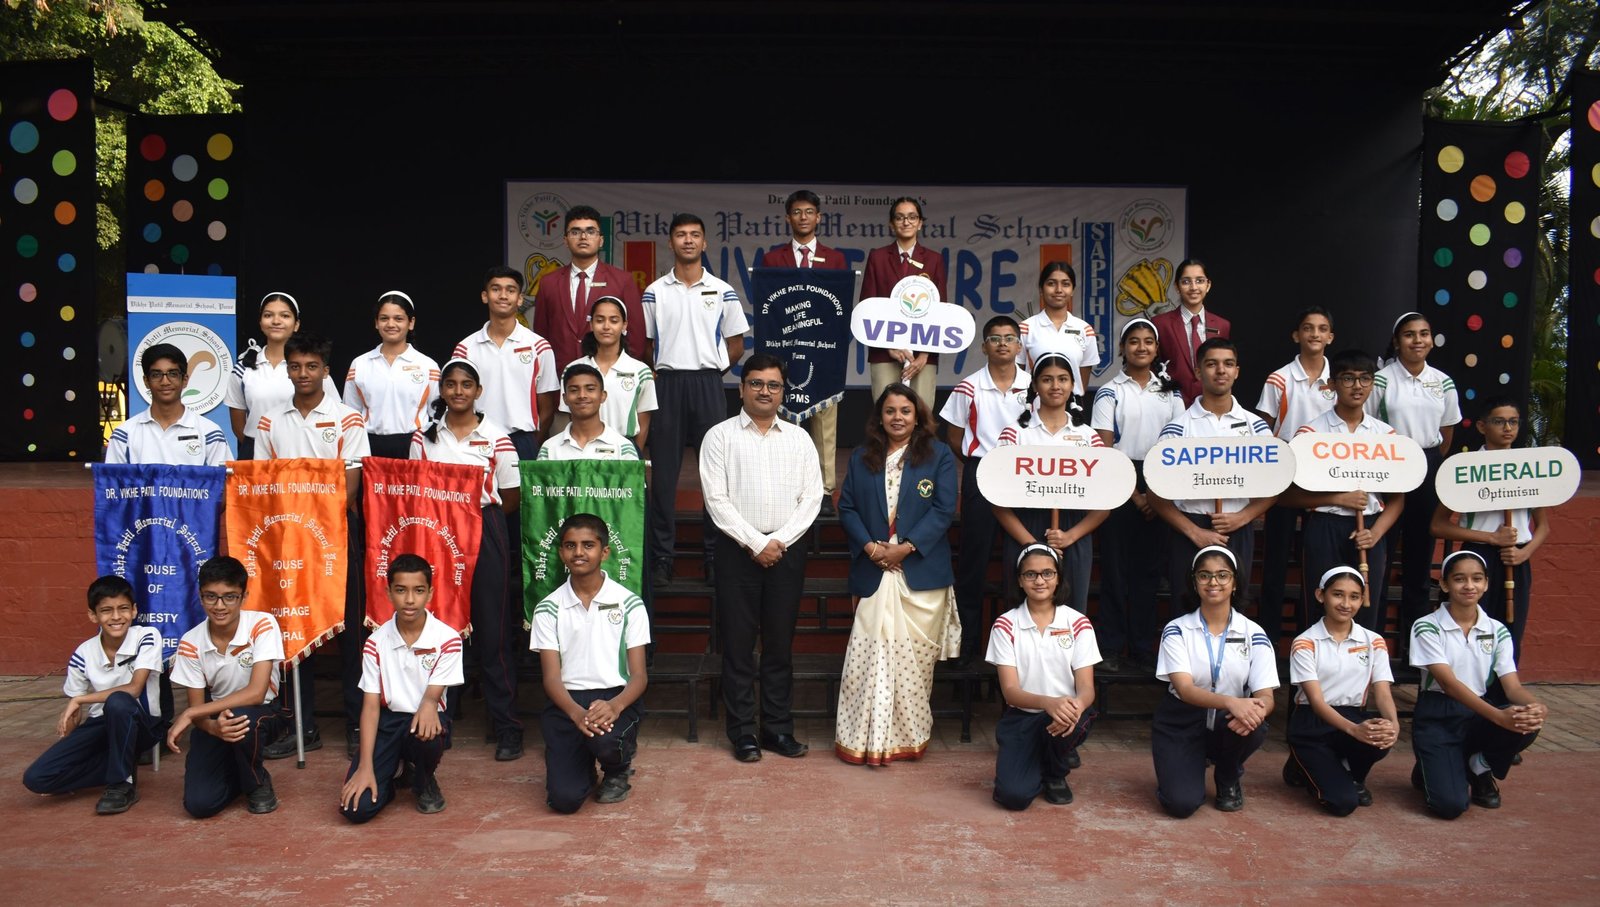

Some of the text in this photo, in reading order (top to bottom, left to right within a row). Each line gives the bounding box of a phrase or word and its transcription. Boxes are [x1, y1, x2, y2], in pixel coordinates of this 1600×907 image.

[768, 195, 785, 204] Dr.
[825, 195, 850, 206] Patil
[613, 210, 671, 241] Vik
[967, 213, 1082, 246] School
[165, 301, 193, 309] Memorial
[217, 303, 234, 311] Pune
[766, 288, 787, 303] VIKHE
[787, 283, 806, 293] PATIL
[805, 284, 844, 316] FOUNDATION'S
[784, 299, 812, 315] MAKING
[793, 310, 807, 322] LIFE
[163, 325, 200, 336] Memorial
[781, 317, 824, 336] MEANINGFUL
[862, 318, 965, 349] VPMS
[188, 393, 220, 412] eaningful
[785, 393, 811, 405] VPMS
[1161, 445, 1280, 466] SAPPHIRE
[1311, 441, 1406, 462] CORAL
[1014, 456, 1100, 477] RUBY
[1328, 466, 1391, 484] Courage
[1454, 459, 1563, 485] EMERALD
[238, 482, 336, 496] DR. VIKHE PATIL FOUNDATION'S
[1025, 480, 1086, 498] Equality
[1192, 472, 1246, 489] Honesty
[105, 485, 209, 499] DR. VIKHE PATIL FOUNDATION'S
[374, 483, 471, 504] DR. VIKHE PATIL FOUNDATION'S
[532, 485, 633, 499] DR. VIKHE PATIL FOUNDATION'S
[1477, 485, 1541, 502] Optimism
[115, 528, 135, 552] Patil
[134, 517, 177, 535] Memorial
[176, 523, 207, 556] School
[303, 518, 334, 550] School
[380, 524, 398, 548] Patil
[398, 516, 440, 532] Memorial
[437, 525, 465, 558] School
[539, 526, 559, 550] Patil
[535, 551, 548, 581] Vikhe
[618, 556, 631, 581] Pune
[147, 584, 164, 594] OF
[279, 579, 295, 589] OF
